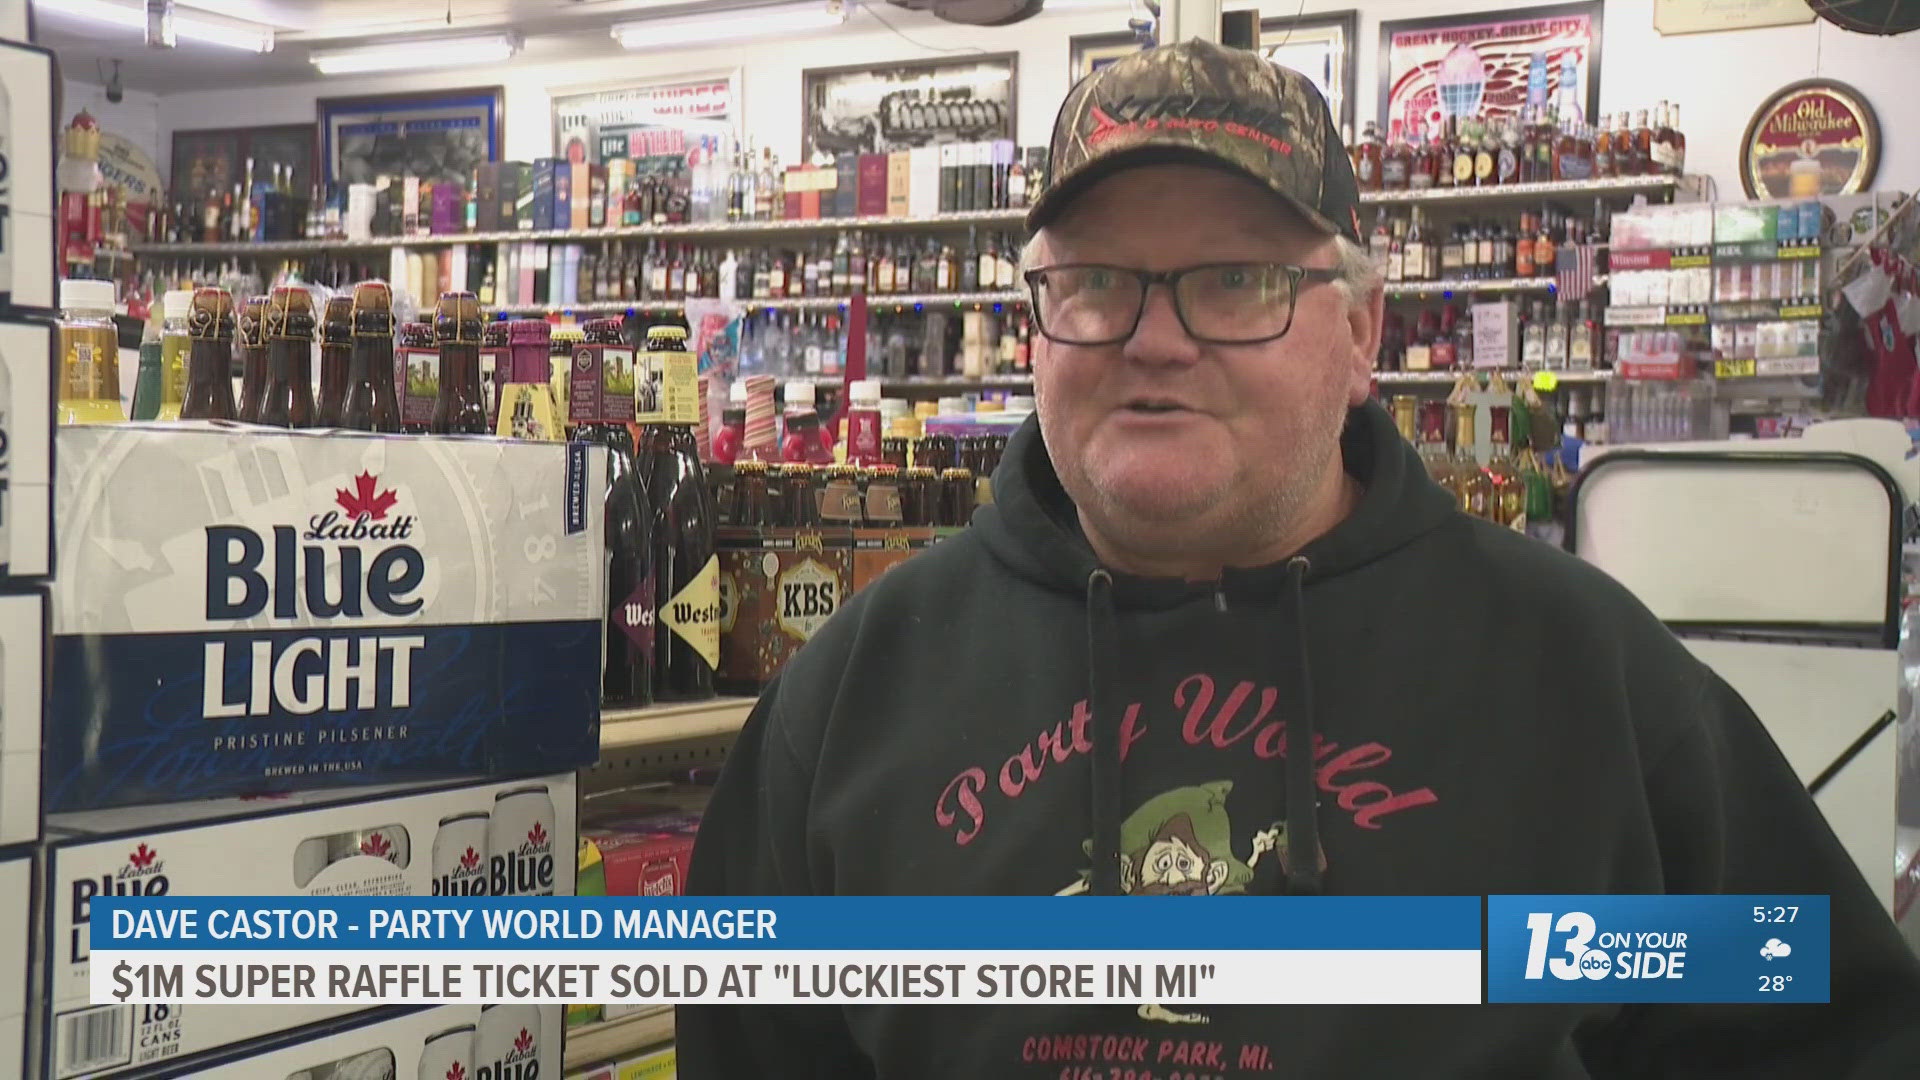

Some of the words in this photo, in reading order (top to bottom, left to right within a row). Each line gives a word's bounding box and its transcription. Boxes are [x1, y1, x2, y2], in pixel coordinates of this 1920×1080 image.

[1395, 35, 1438, 48] GREAT
[1501, 22, 1547, 37] GREAT
[1797, 99, 1825, 119] Old
[1769, 110, 1853, 134] Milwaukee
[1165, 118, 1219, 131] AUTO
[1224, 121, 1292, 157] CENTER
[1611, 253, 1650, 266] Winston
[303, 510, 414, 540] Labatt
[205, 524, 425, 621] Blue
[783, 581, 834, 618] KBS
[202, 634, 425, 719] LIGHT
[213, 731, 306, 751] PRISTINE
[318, 724, 409, 744] PILSENER
[1174, 673, 1438, 829] World
[264, 765, 305, 778] BREWED
[308, 764, 319, 774] IN
[344, 760, 363, 771] USA
[517, 842, 551, 857] Labatt
[116, 860, 165, 880] Labatt
[451, 863, 485, 880] Labatt
[490, 850, 554, 896] Blue
[142, 1004, 169, 1025] 18
[140, 1029, 181, 1048] CANS
[162, 1043, 180, 1057] BEER
[505, 1046, 537, 1065] Labatt
[1022, 1034, 1149, 1063] COMSTOCK
[1157, 1040, 1228, 1071] PARK,
[1239, 1044, 1274, 1071] MI.
